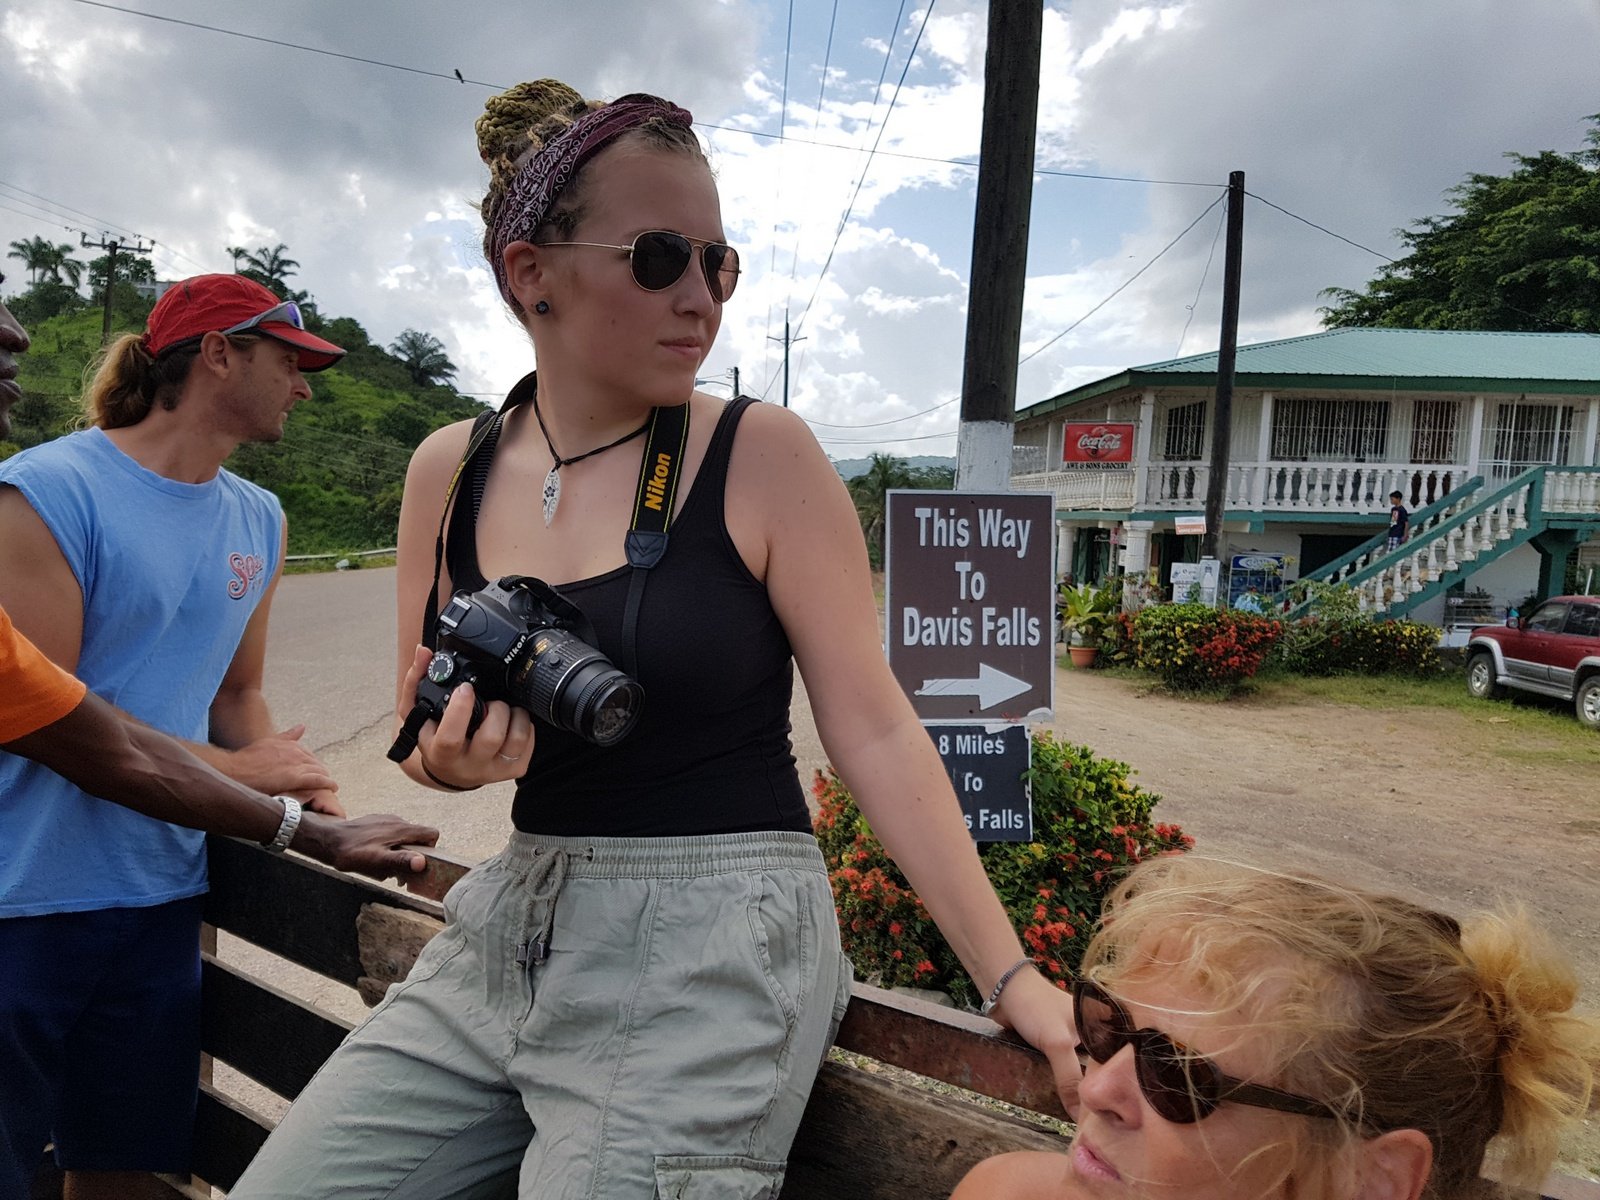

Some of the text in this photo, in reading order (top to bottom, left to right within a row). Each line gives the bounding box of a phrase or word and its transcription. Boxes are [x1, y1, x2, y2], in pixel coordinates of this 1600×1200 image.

[644, 453, 671, 511] Nikon
[914, 507, 1032, 559] This Way
[954, 561, 986, 601] To
[903, 606, 1041, 646] Davis Falls
[503, 634, 527, 665] Nikon
[955, 734, 1005, 755] Miles
[979, 808, 1024, 830] Falls
